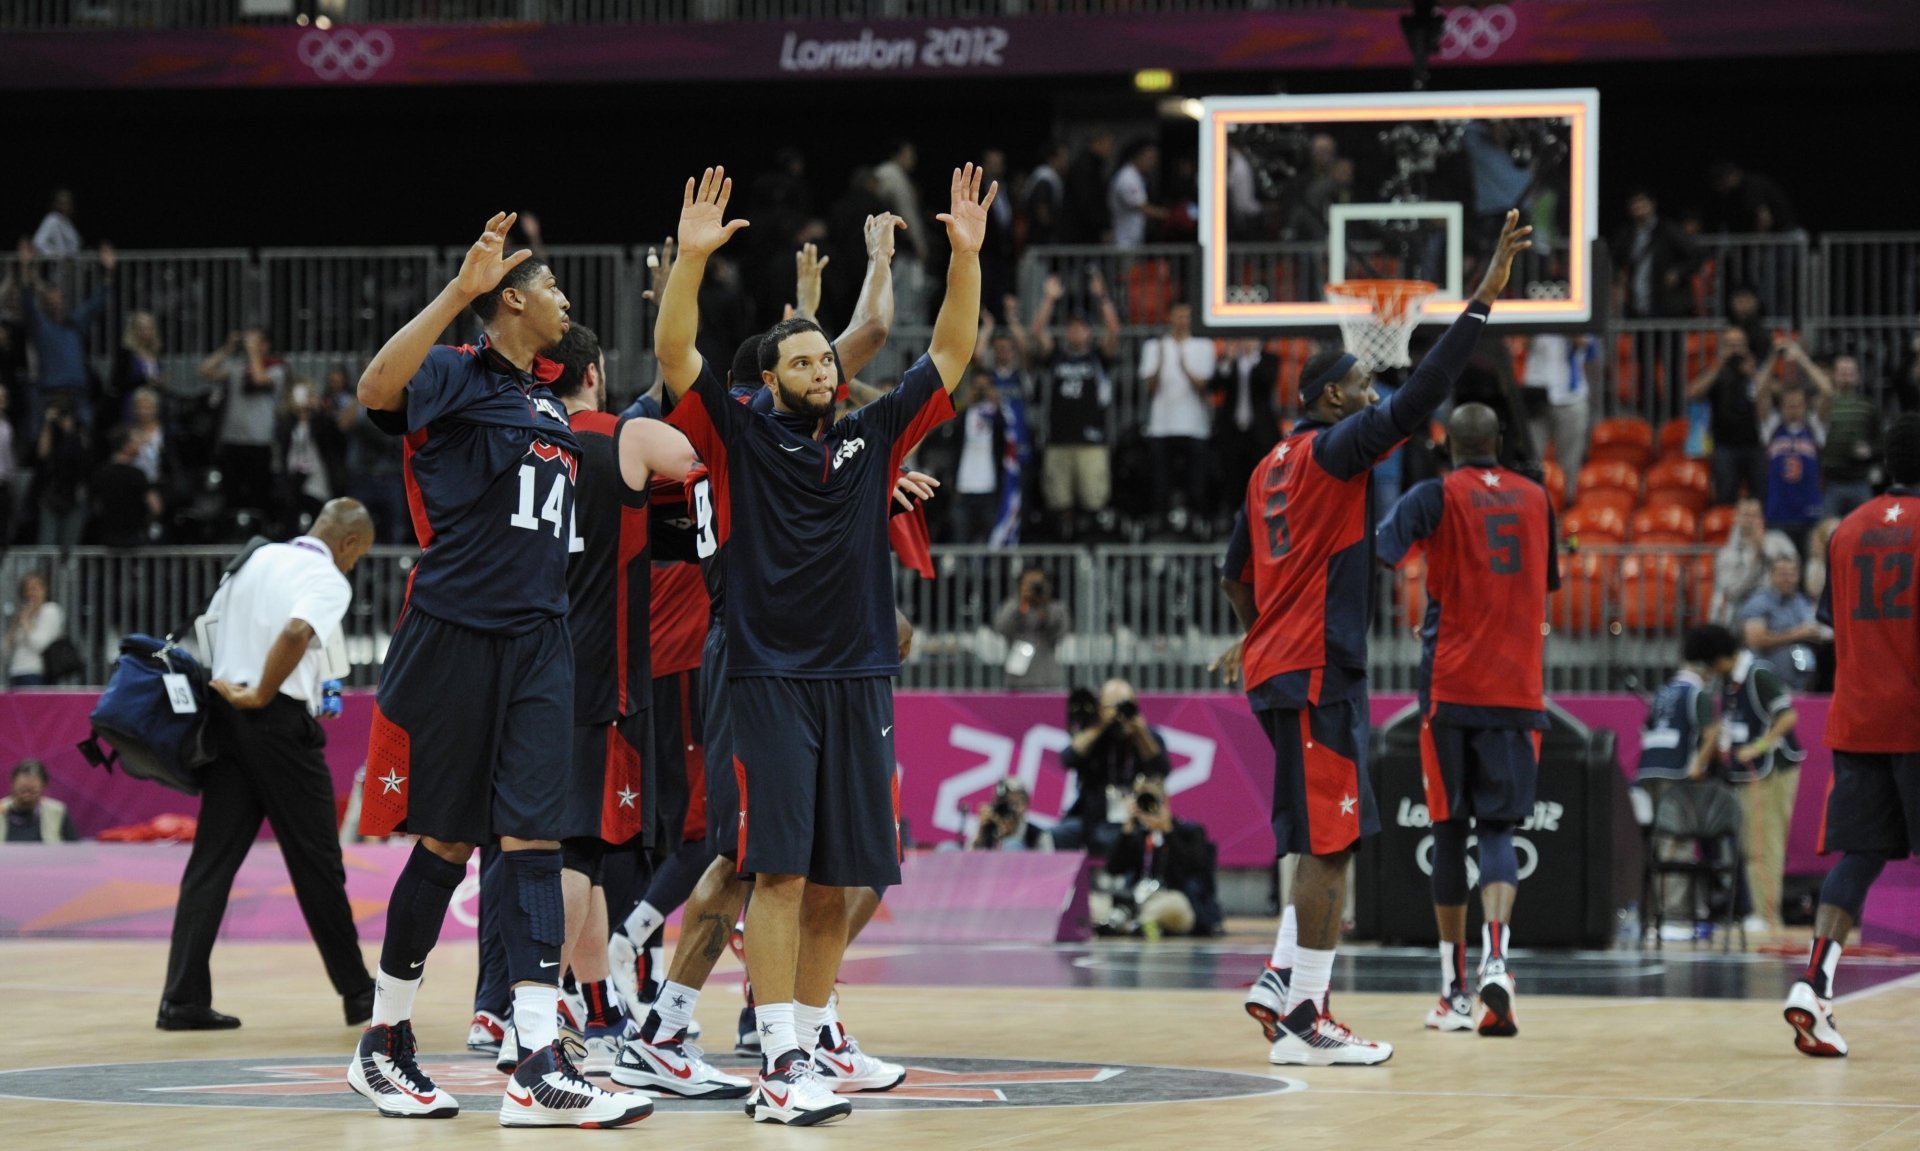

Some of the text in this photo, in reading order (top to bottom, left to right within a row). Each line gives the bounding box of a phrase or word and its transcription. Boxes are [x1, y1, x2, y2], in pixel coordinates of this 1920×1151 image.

[779, 26, 1010, 71] London 2012
[832, 437, 865, 470] USA
[510, 463, 566, 539] 14
[694, 478, 718, 559] 9
[1264, 491, 1292, 559] 6
[1484, 512, 1523, 575] 5
[1852, 552, 1914, 620] 12
[931, 722, 1217, 838] 202
